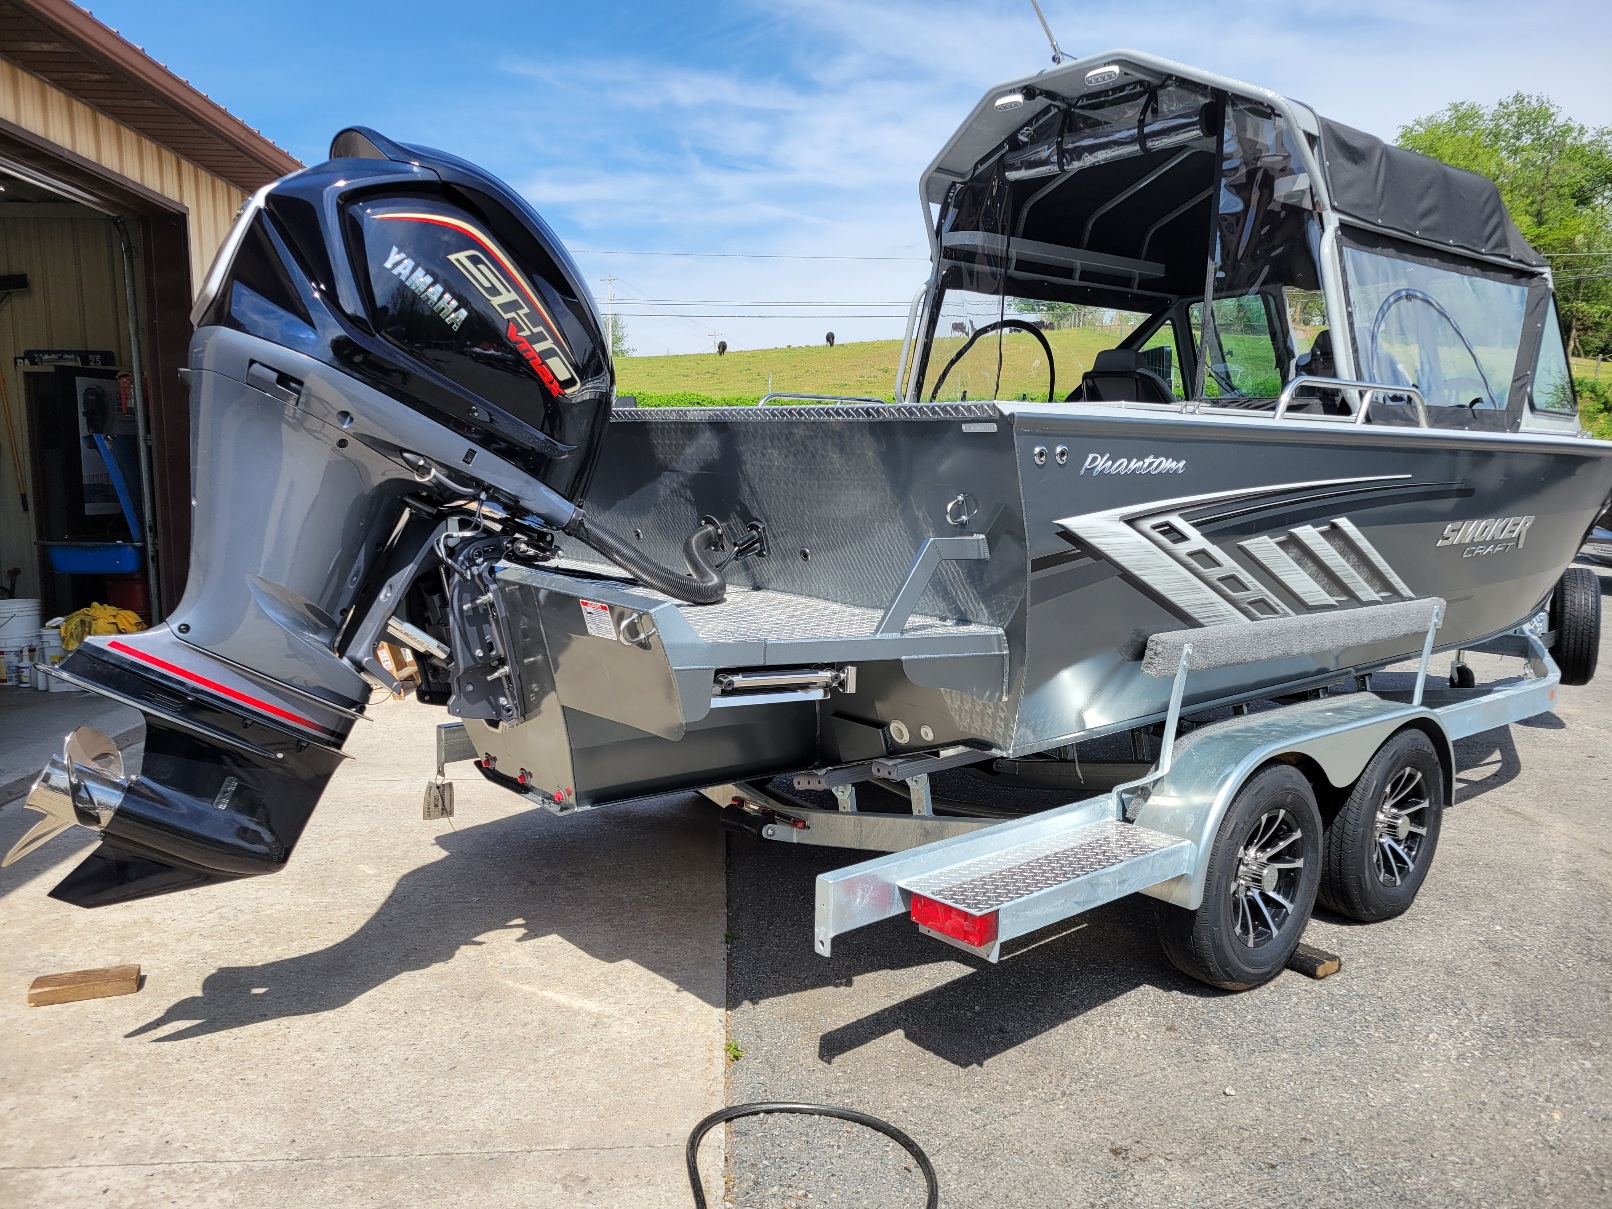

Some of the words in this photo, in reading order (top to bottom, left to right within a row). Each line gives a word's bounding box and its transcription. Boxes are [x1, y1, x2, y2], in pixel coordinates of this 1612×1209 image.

[383, 245, 469, 332] YAMAHA
[446, 250, 582, 395] SHO
[1079, 452, 1187, 477] Phantom
[1435, 515, 1536, 549] SMOKER
[1462, 541, 1516, 558] CRAFT
